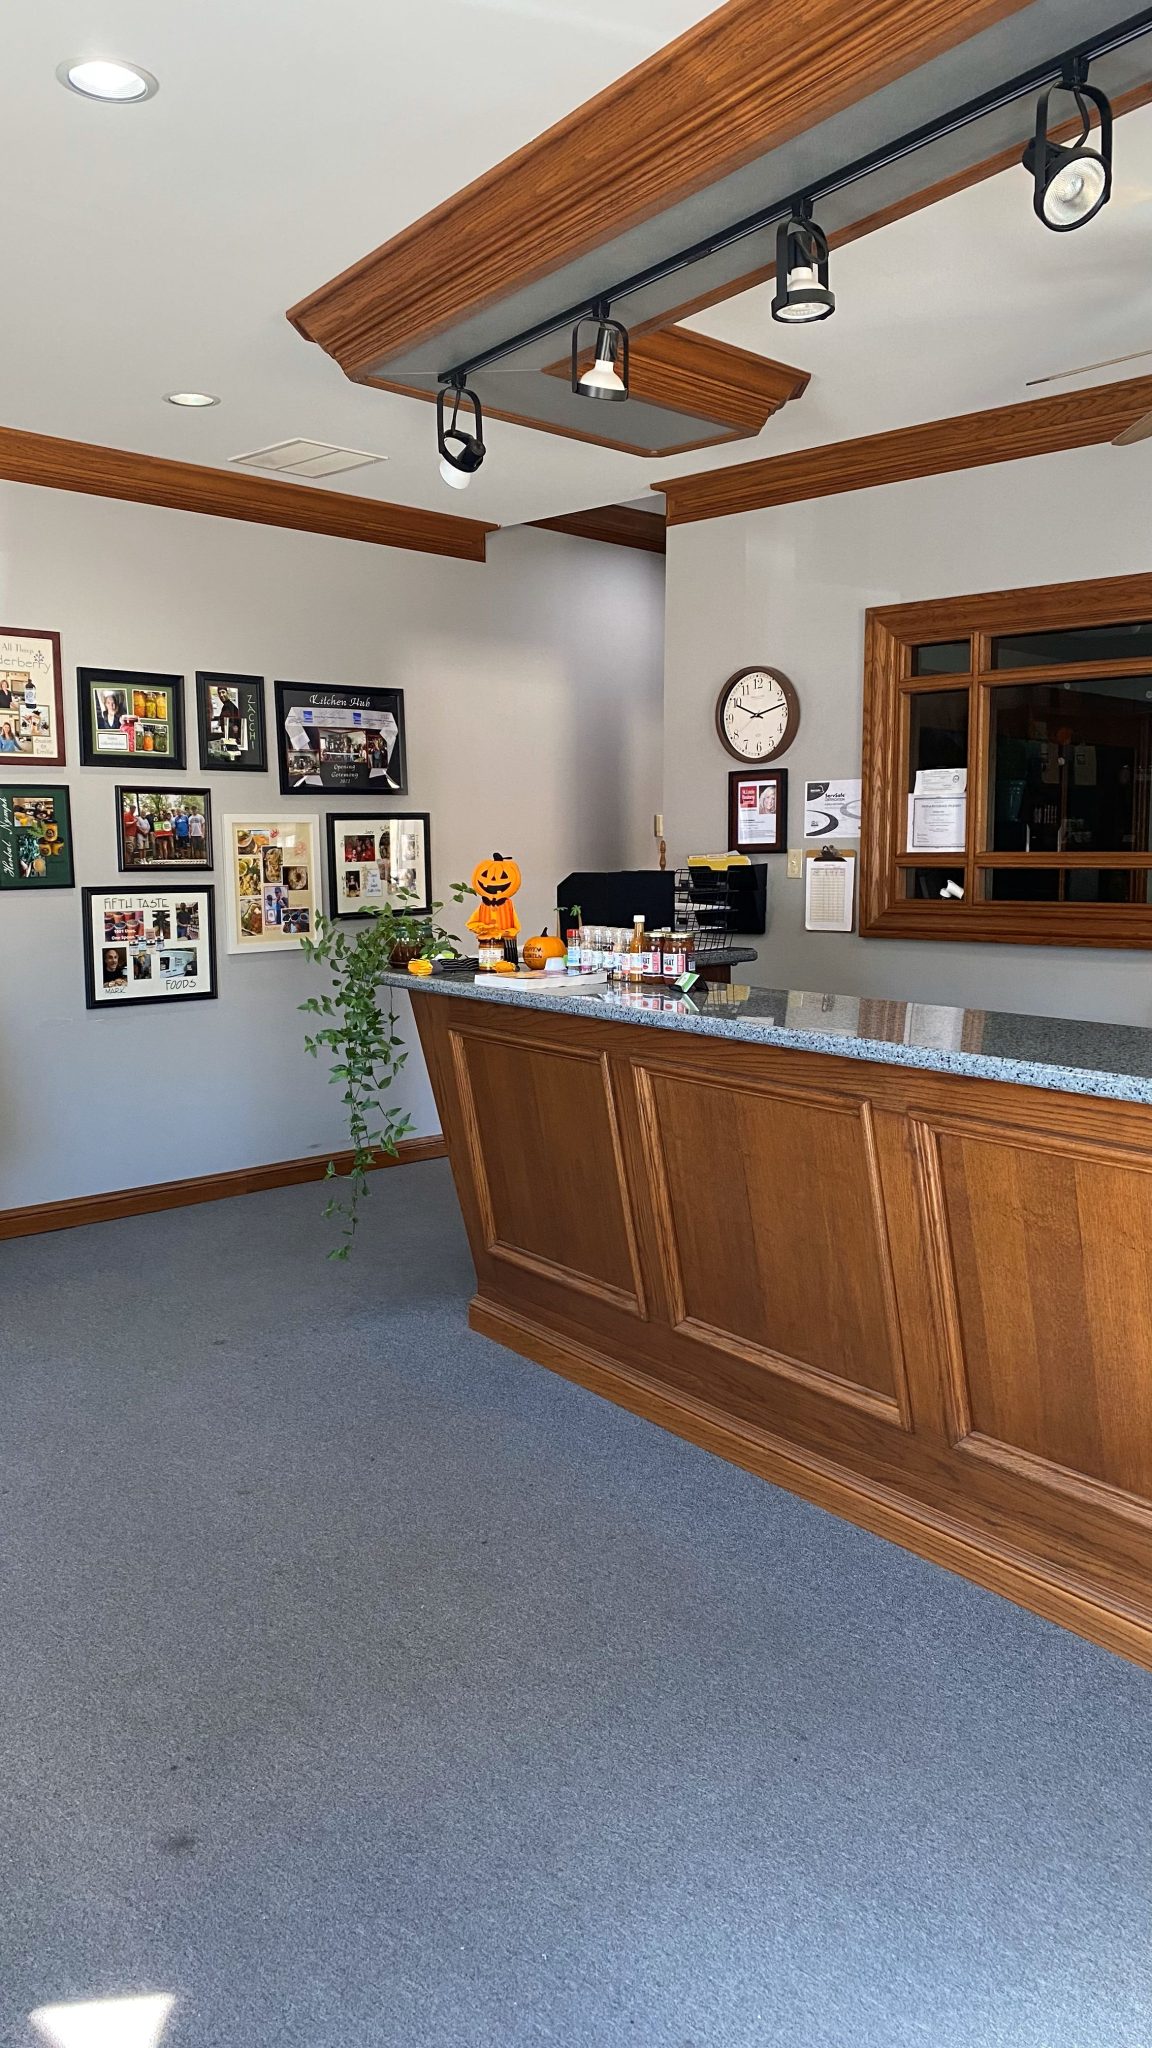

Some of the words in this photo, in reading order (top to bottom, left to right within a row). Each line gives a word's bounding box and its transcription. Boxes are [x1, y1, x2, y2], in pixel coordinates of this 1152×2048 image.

[2, 643, 12, 652] All
[754, 678, 763, 689] 12
[742, 684, 750, 696] 11
[777, 690, 783, 701] 2
[309, 694, 347, 706] Kitchen
[349, 697, 371, 707] Hub
[733, 697, 742, 708] 10
[782, 706, 788, 717] 3
[247, 694, 256, 750] ZACCHI
[729, 714, 734, 724] 9
[777, 722, 783, 733] 4
[733, 729, 739, 739] 8
[743, 739, 749, 750] 7
[756, 741, 762, 752] 6
[769, 736, 775, 747] 5
[2, 839, 15, 878] Herbal
[104, 898, 133, 910] FIFTH
[136, 898, 170, 908] TASTE
[165, 979, 197, 991] FOODS
